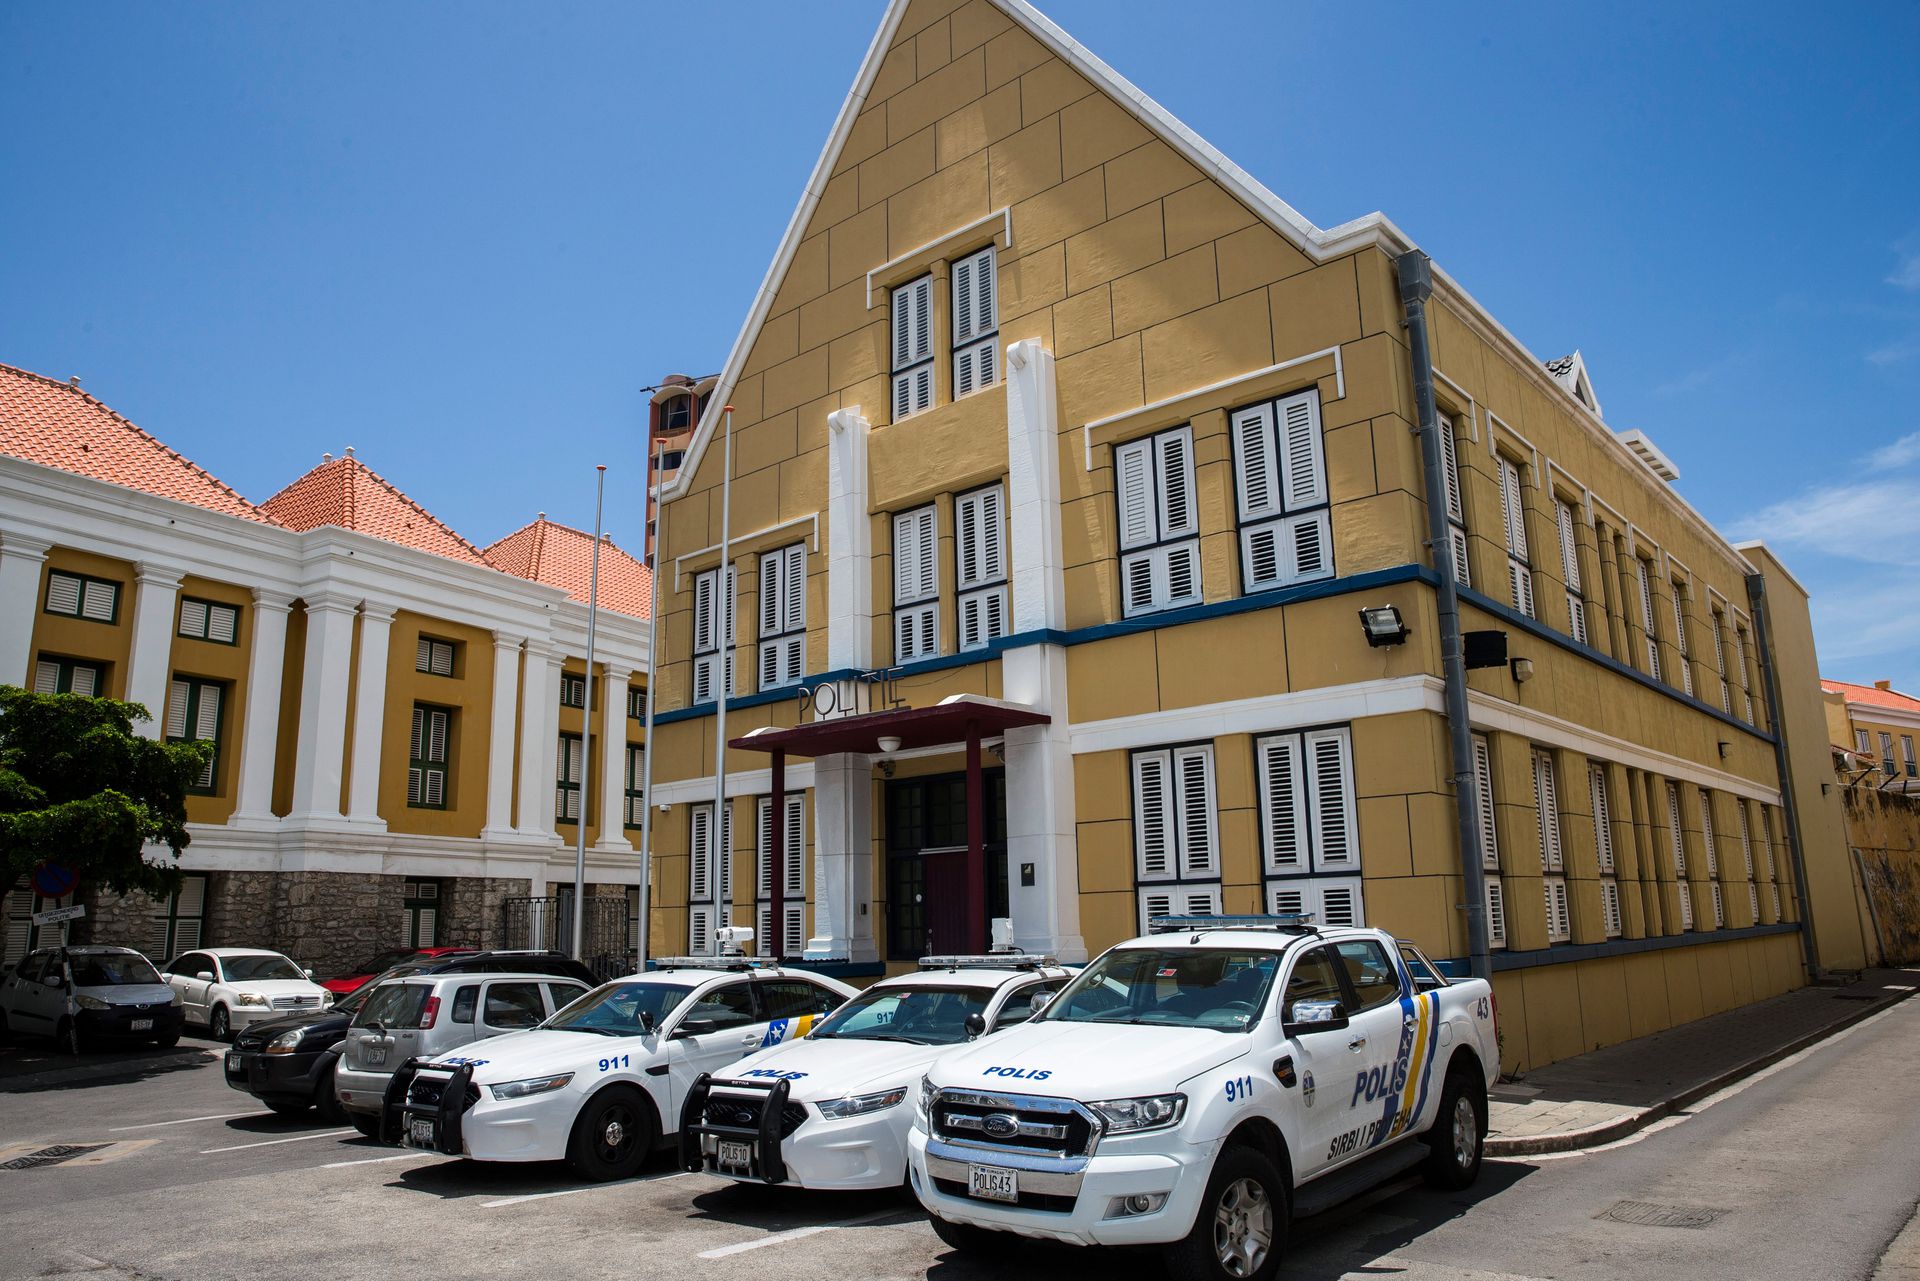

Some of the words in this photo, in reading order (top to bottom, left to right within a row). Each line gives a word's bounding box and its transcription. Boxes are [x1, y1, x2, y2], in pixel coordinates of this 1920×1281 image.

[798, 667, 906, 722] POLITIE
[1476, 997, 1489, 1020] 43
[598, 1054, 630, 1072] 911
[738, 1069, 809, 1080] POLIS
[982, 1066, 1053, 1081] POLIS
[1225, 1075, 1253, 1102] 911
[1351, 1057, 1409, 1108] POLIS
[986, 1119, 1010, 1132] Ford
[1327, 1127, 1361, 1160] SIRBI
[1359, 1124, 1367, 1147] I
[1366, 1106, 1412, 1145] PRTEHA
